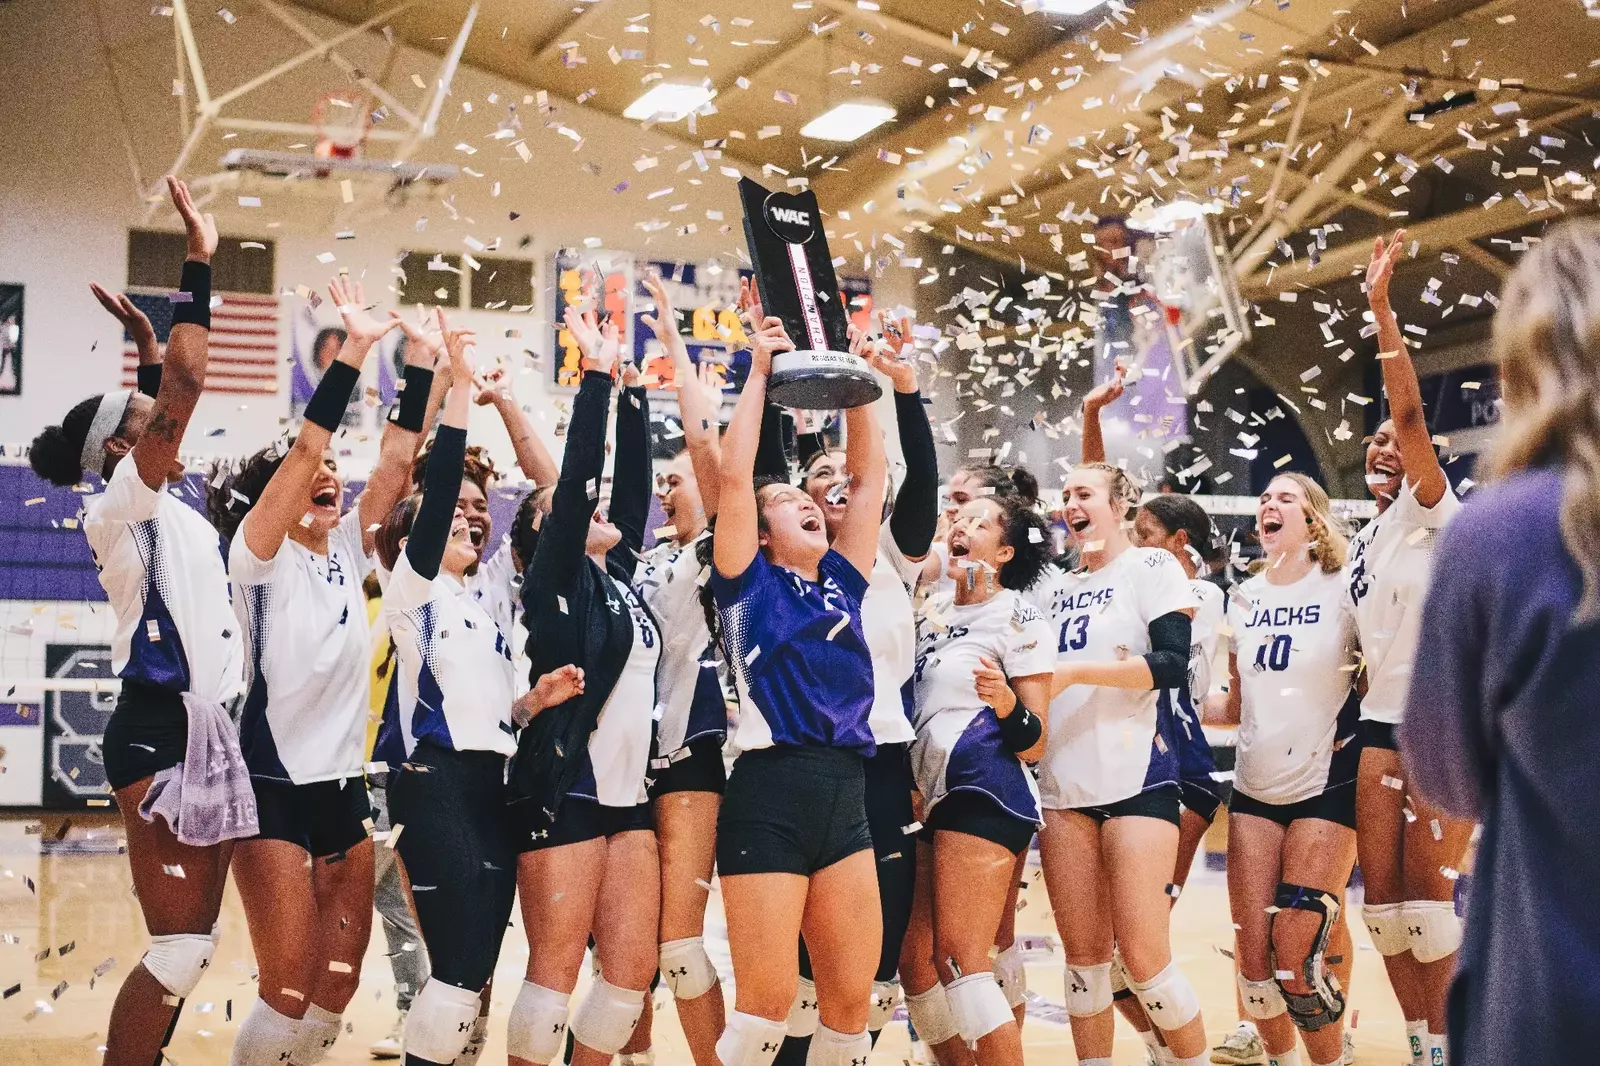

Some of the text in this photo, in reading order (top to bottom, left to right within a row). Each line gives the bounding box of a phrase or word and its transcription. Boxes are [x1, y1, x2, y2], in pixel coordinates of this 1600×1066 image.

[770, 206, 810, 227] WAC
[799, 266, 824, 345] CHAMPION
[1058, 614, 1091, 653] 13
[1245, 605, 1321, 628] JACKS
[1254, 634, 1293, 671] 10
